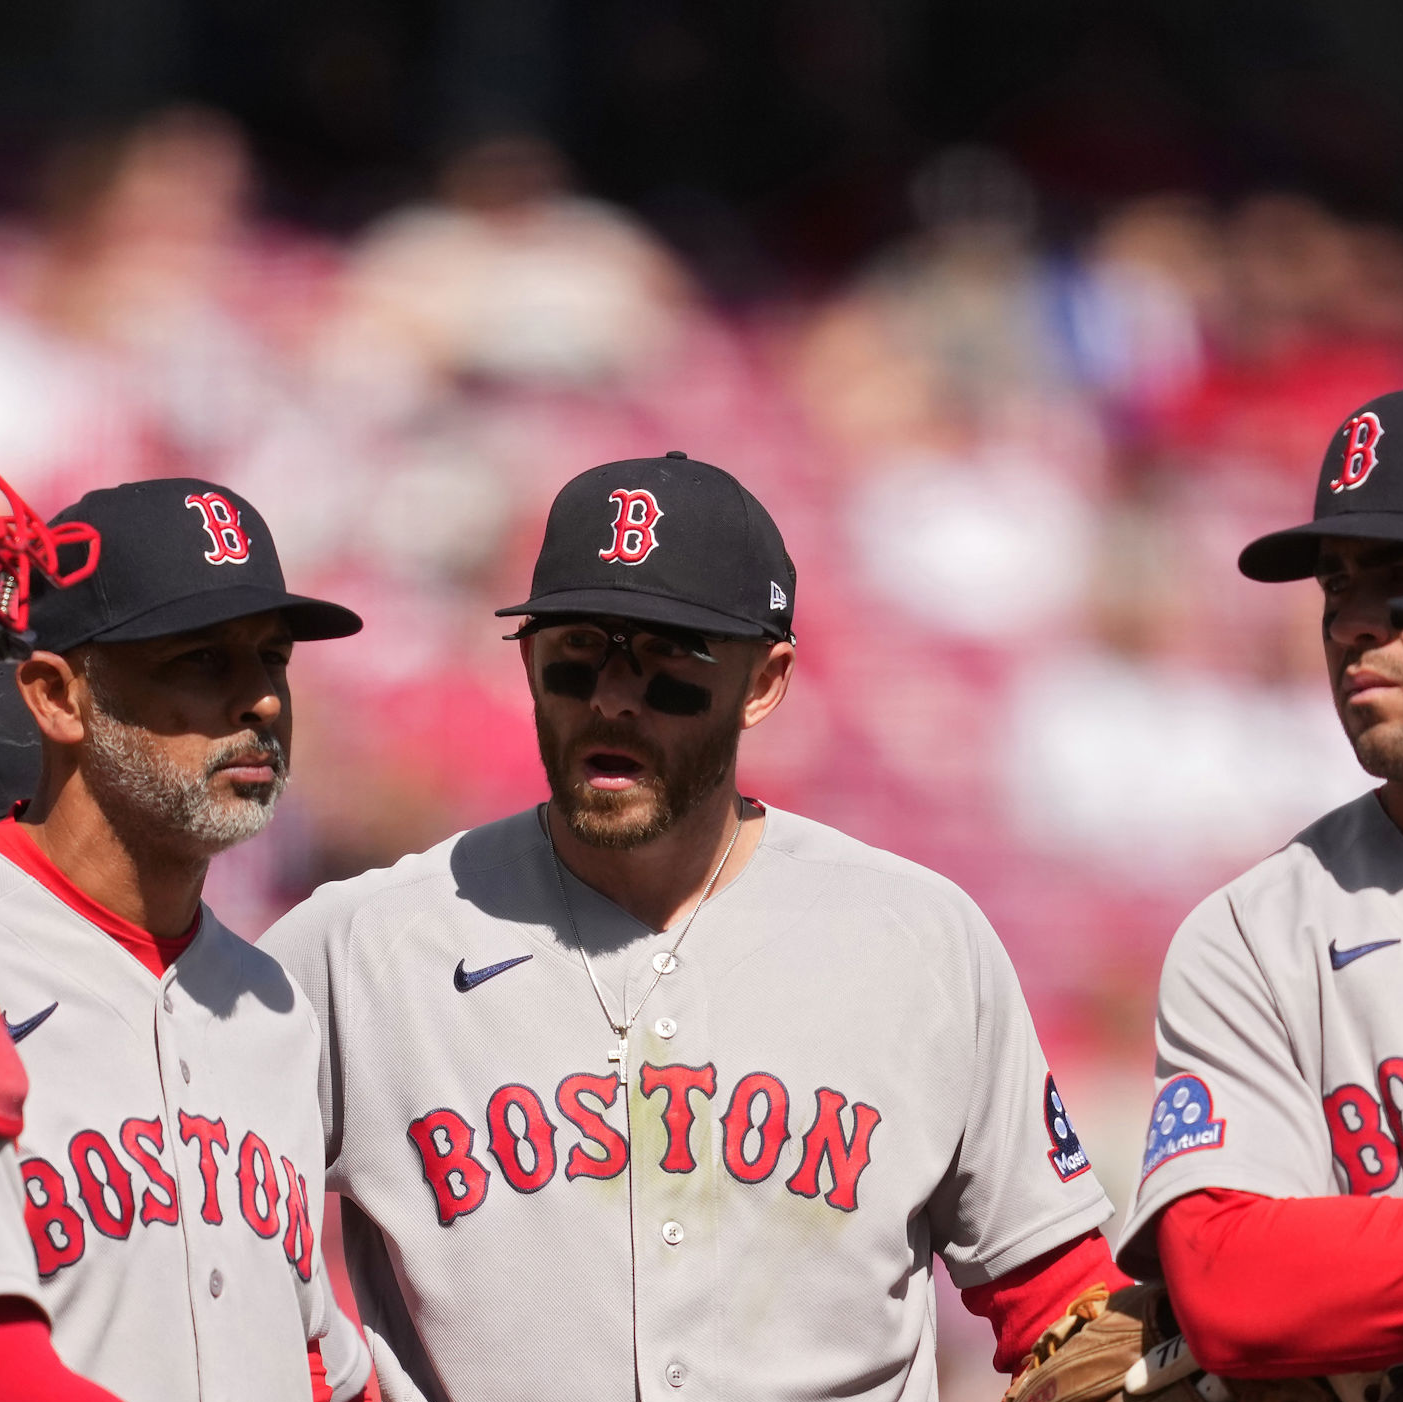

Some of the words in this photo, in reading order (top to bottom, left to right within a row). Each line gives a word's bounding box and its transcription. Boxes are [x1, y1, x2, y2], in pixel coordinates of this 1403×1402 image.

[1330, 411, 1385, 494] B
[185, 492, 252, 565] B
[598, 488, 665, 566] B
[407, 1060, 882, 1227] BOSTON
[19, 1108, 314, 1284] BOSTON
